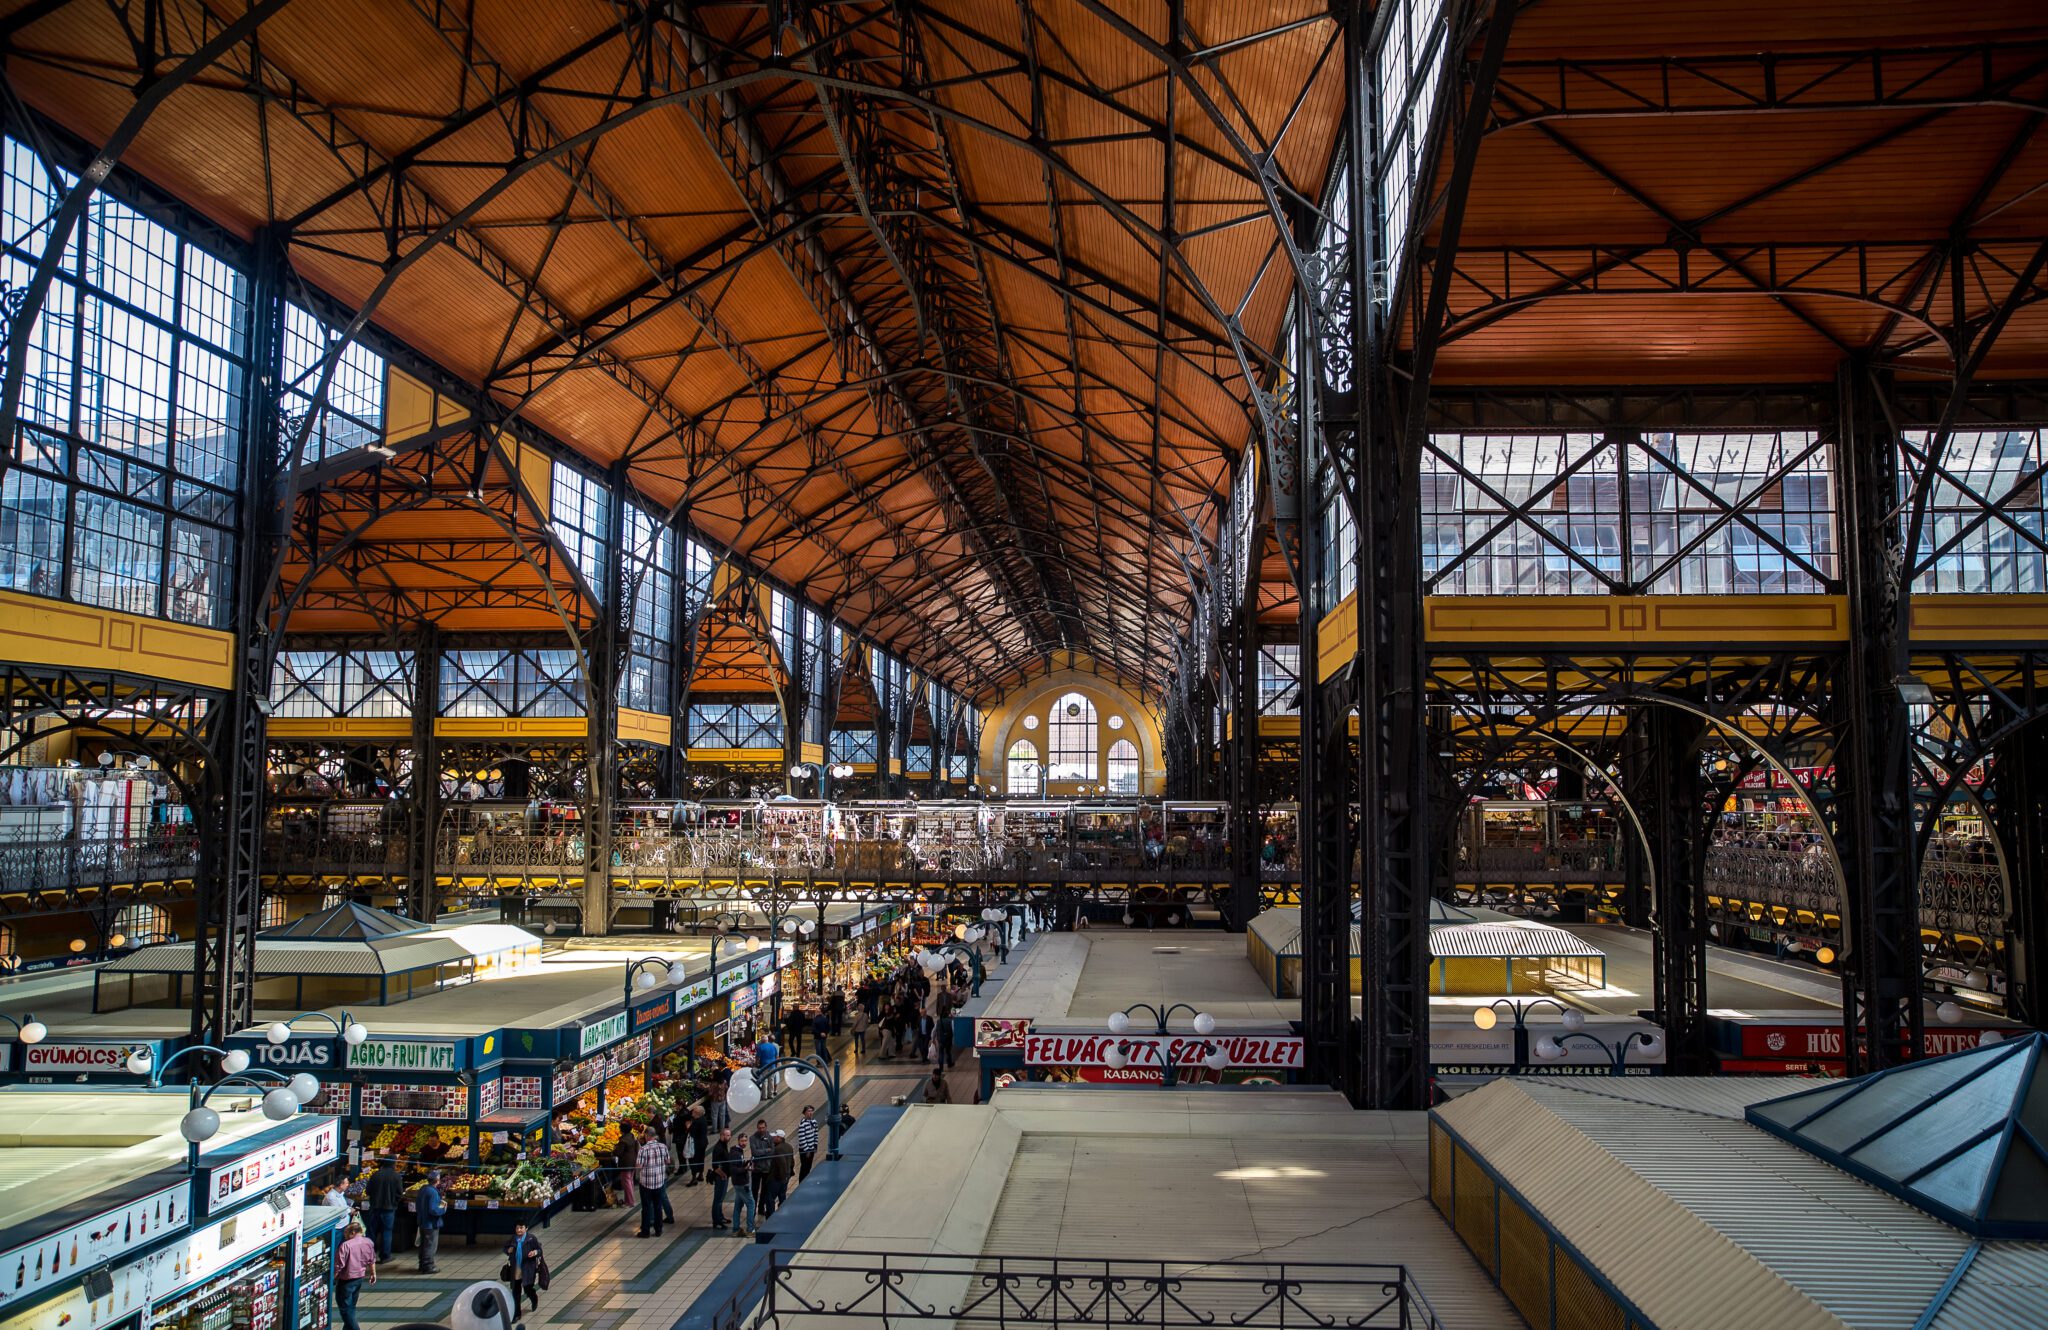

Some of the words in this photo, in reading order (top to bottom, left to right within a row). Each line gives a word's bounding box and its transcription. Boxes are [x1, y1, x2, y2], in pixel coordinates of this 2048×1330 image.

[583, 1018, 616, 1051] AGRO-FRUIT
[1807, 1028, 1840, 1053] HÚS
[28, 1046, 118, 1065] GYÜMÖLCS
[256, 1041, 329, 1065] TOJÁS
[350, 1043, 427, 1067] AGRO-FRUIT
[430, 1046, 454, 1069] KFT.
[1169, 1037, 1303, 1064] SZAÜZLET
[1437, 1065, 1511, 1074] KOLBÁSZ
[1519, 1065, 1612, 1075] SZAKÜZLET
